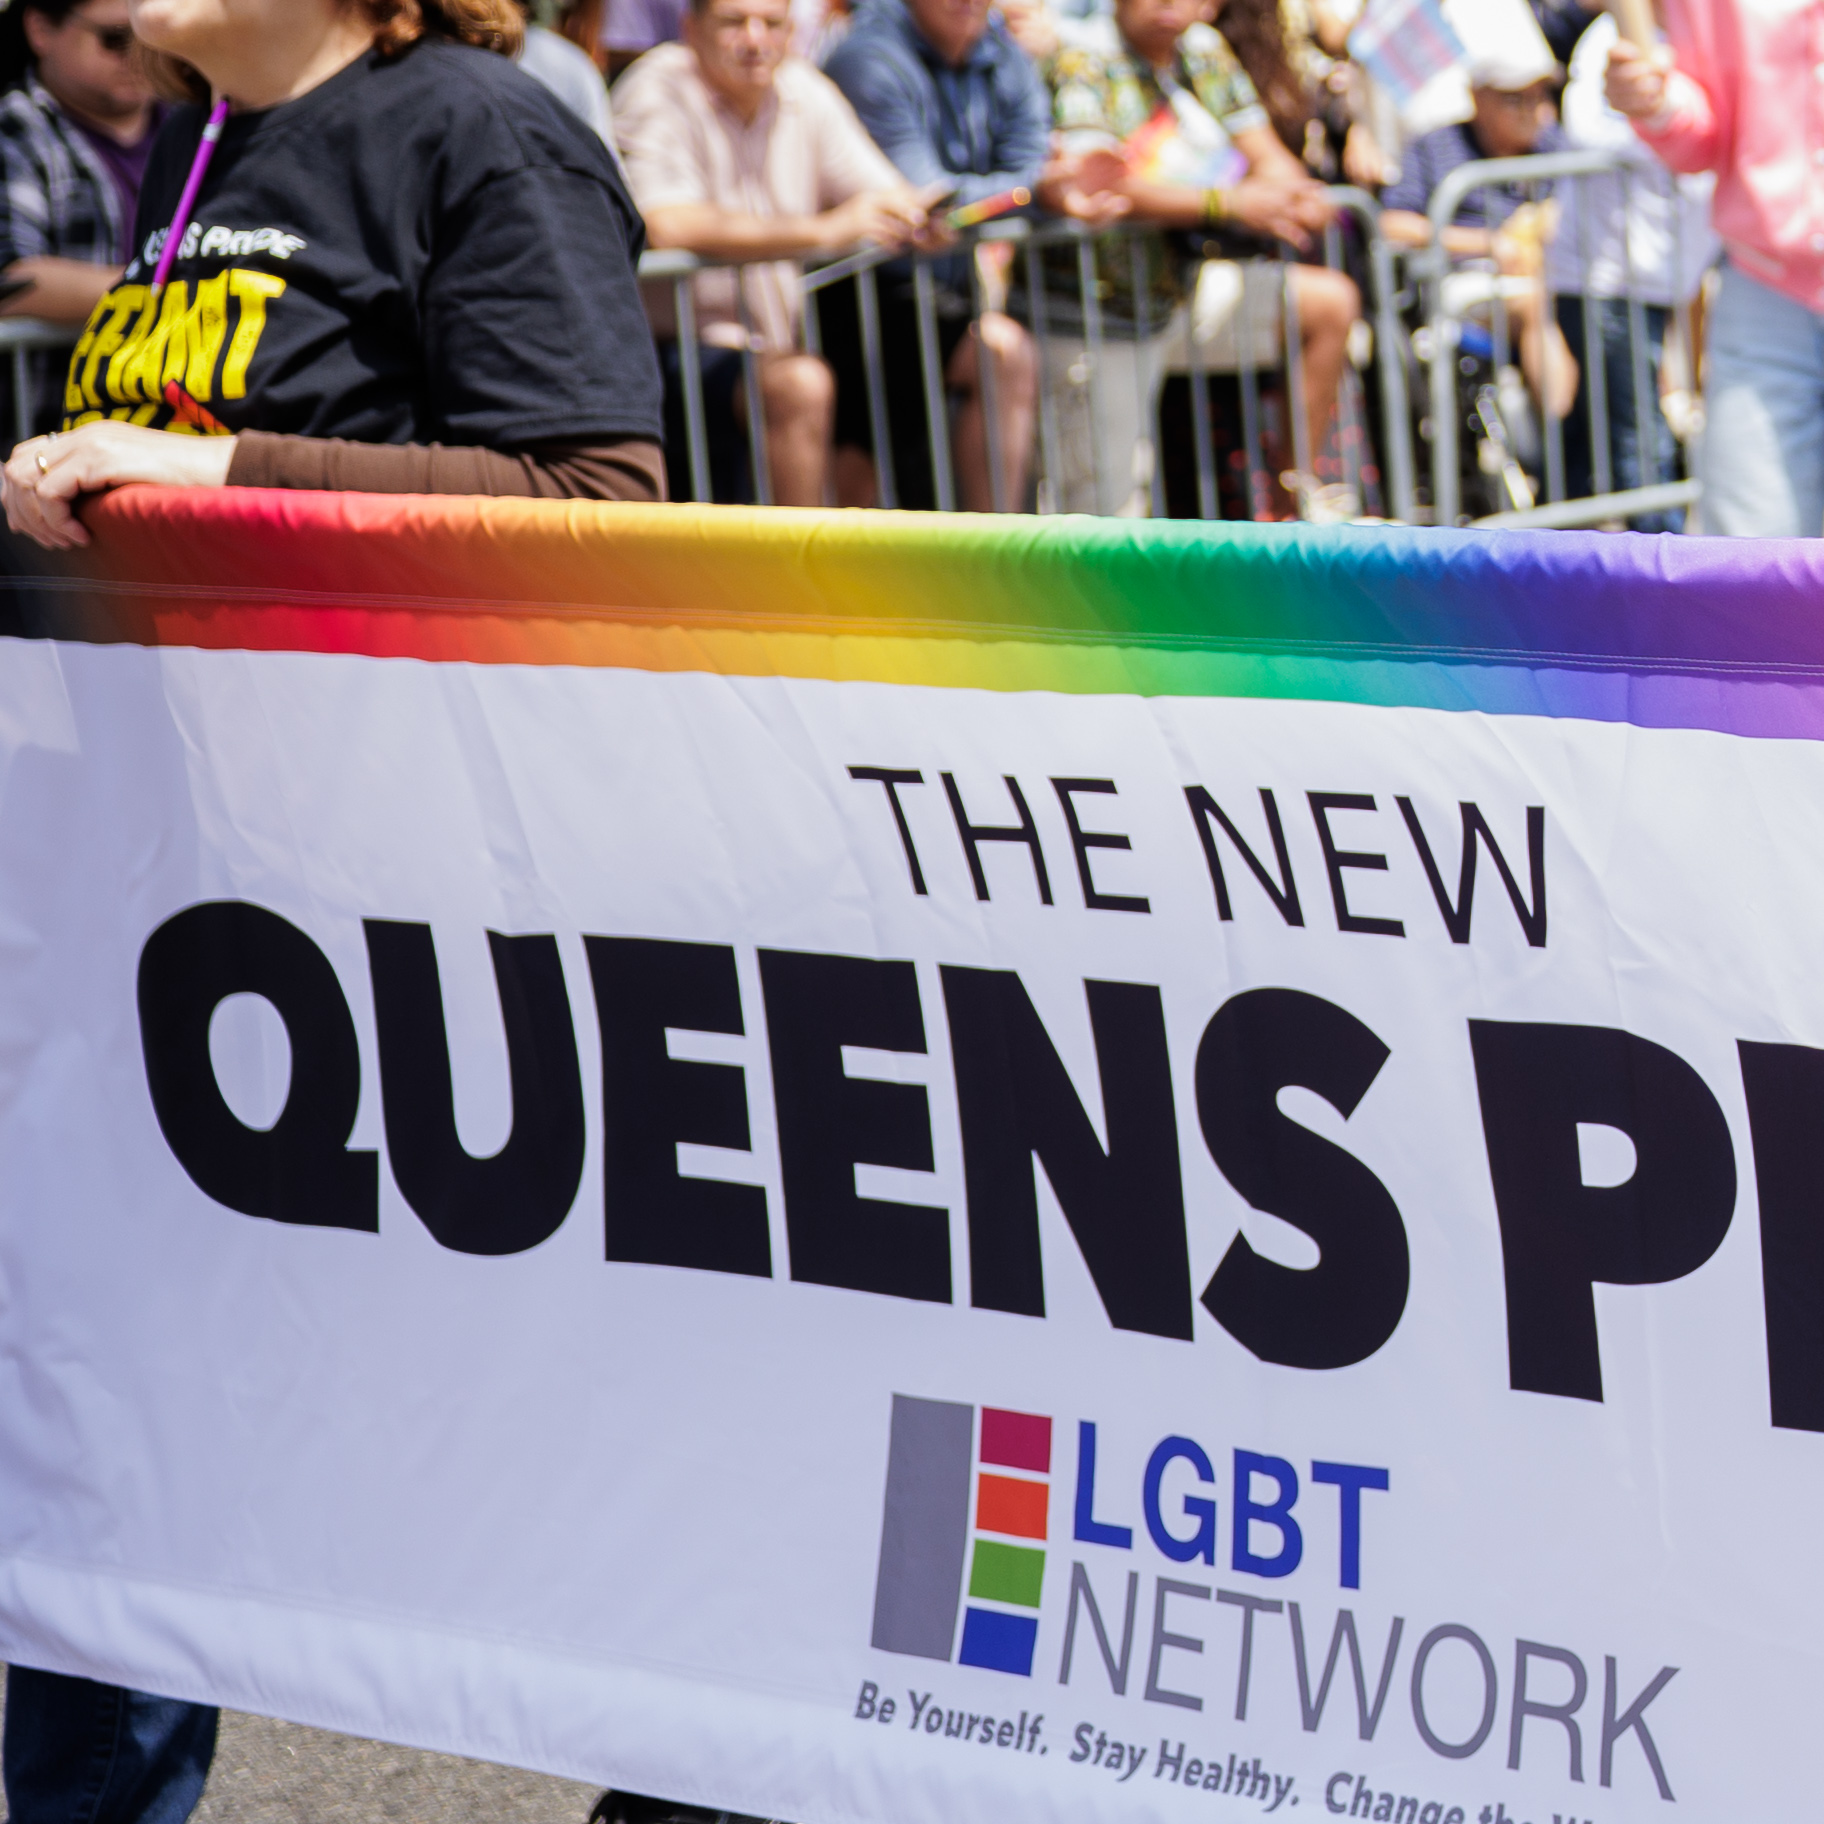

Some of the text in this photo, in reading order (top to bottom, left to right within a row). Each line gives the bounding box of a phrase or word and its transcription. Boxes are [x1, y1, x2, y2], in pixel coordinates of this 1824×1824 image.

[845, 764, 1547, 948] THE NEW
[135, 898, 1411, 1372] QUEENS
[1072, 1419, 1390, 1591] LGBT
[854, 1680, 896, 1726] Be
[907, 1687, 1050, 1758] Yourself.
[1068, 1720, 1147, 1784] Stay
[1156, 1738, 1303, 1814] Healthy.
[1058, 1560, 1681, 1803] NETWORK
